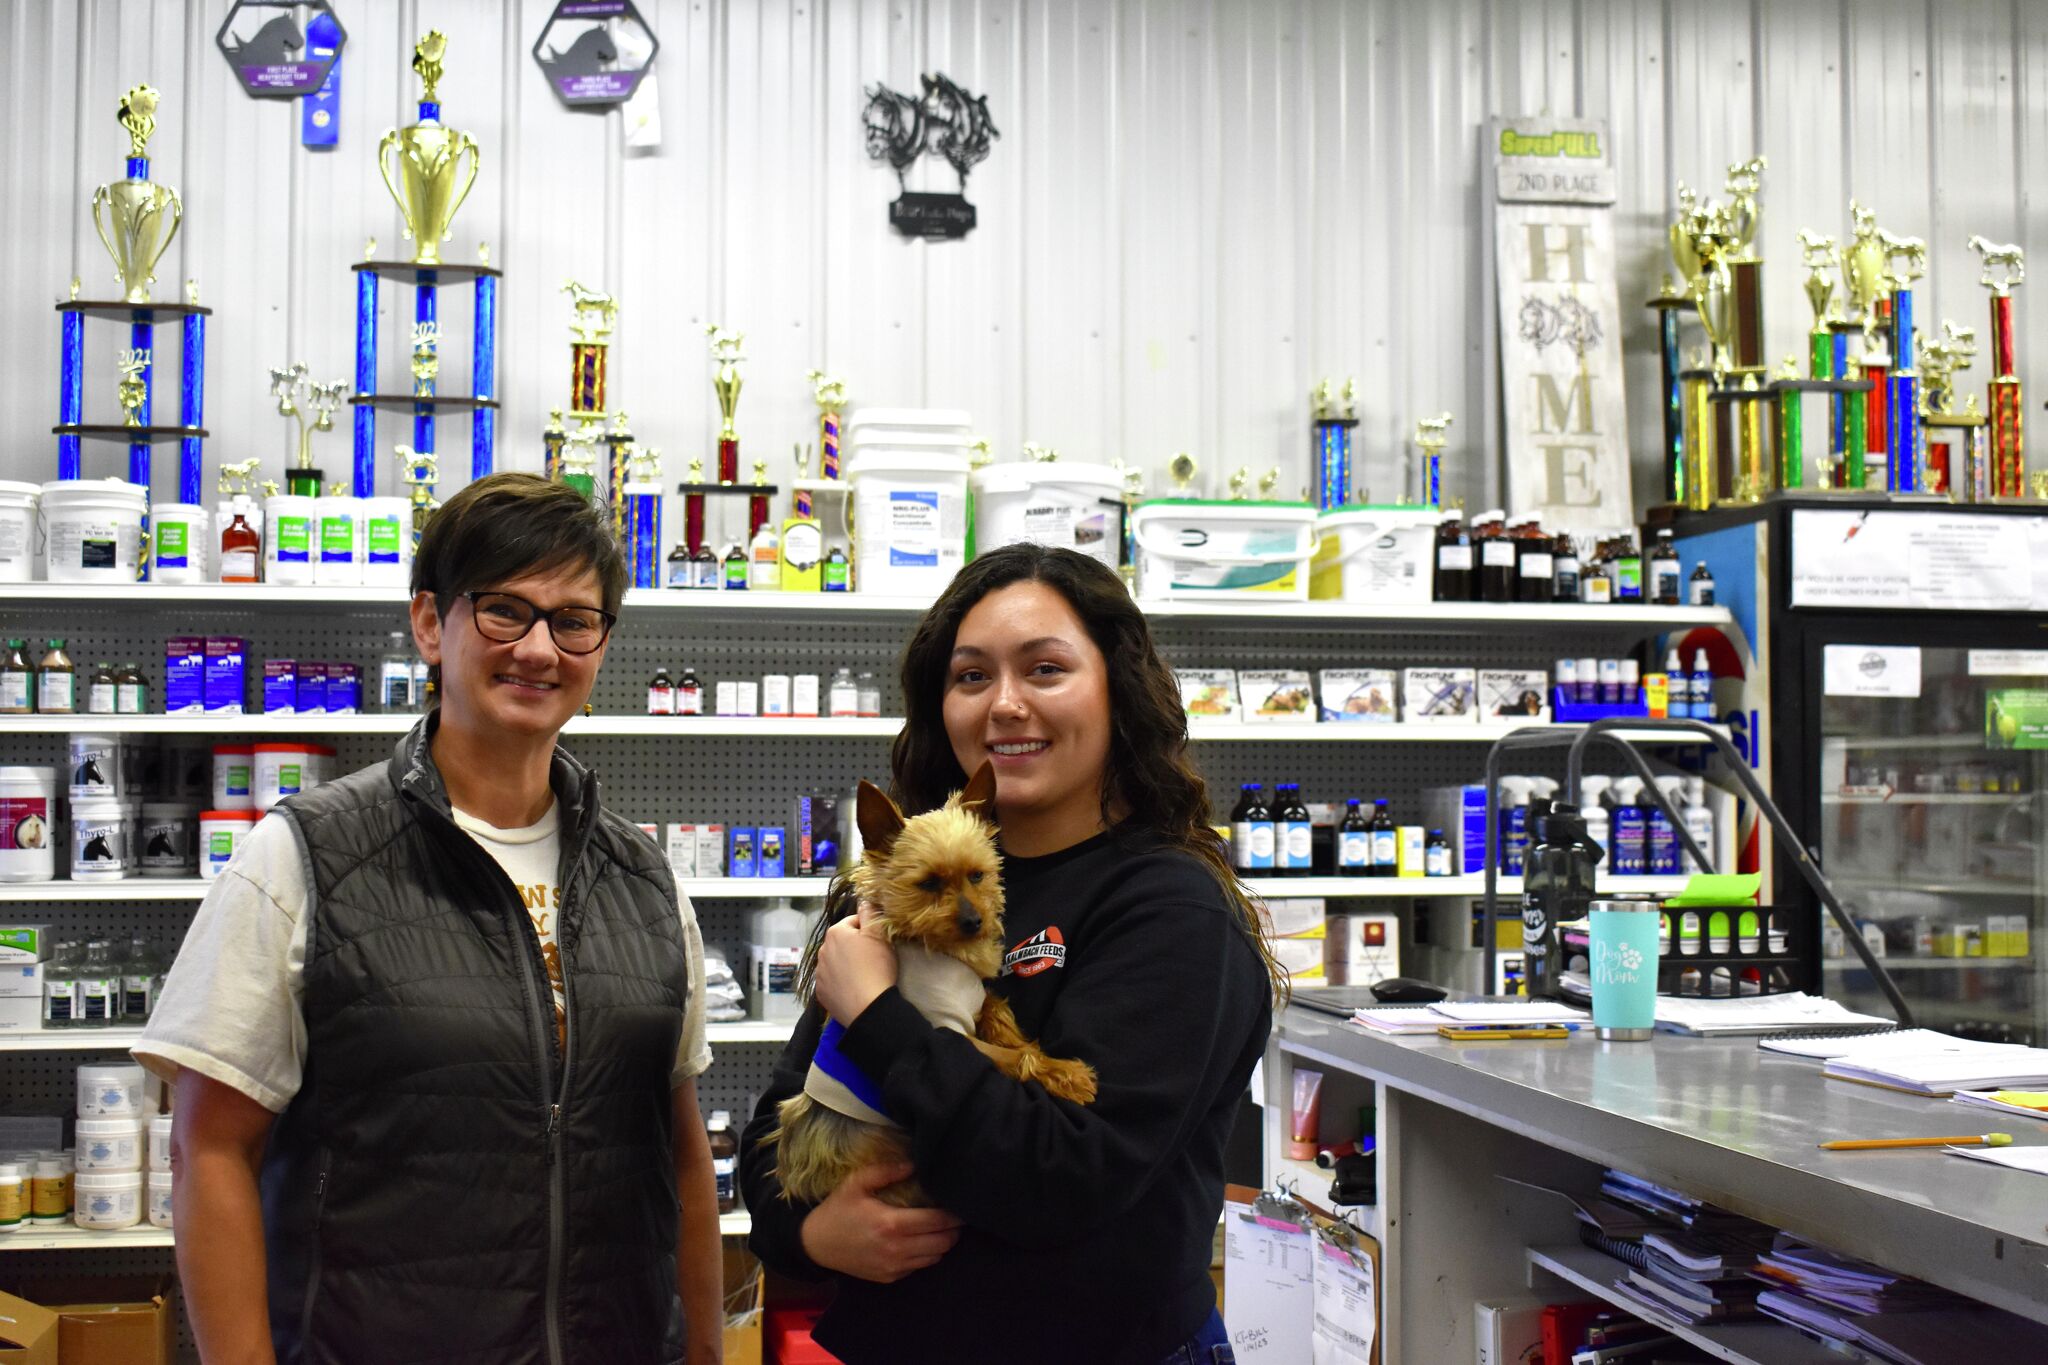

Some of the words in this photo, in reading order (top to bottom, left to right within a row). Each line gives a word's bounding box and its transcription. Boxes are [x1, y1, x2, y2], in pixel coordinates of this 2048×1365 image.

[1517, 174, 1547, 192] 2ND
[1552, 175, 1599, 193] PLACE
[117, 349, 151, 366] 2021
[1409, 671, 1456, 680] FRONTLINE
[1482, 673, 1528, 682] FRONTLINE
[72, 750, 106, 765] Thyro-L
[80, 825, 115, 839] Thyro-L
[1040, 945, 1064, 957] FEEDS
[1595, 940, 1622, 969] Dog
[1595, 963, 1641, 985] Mom
